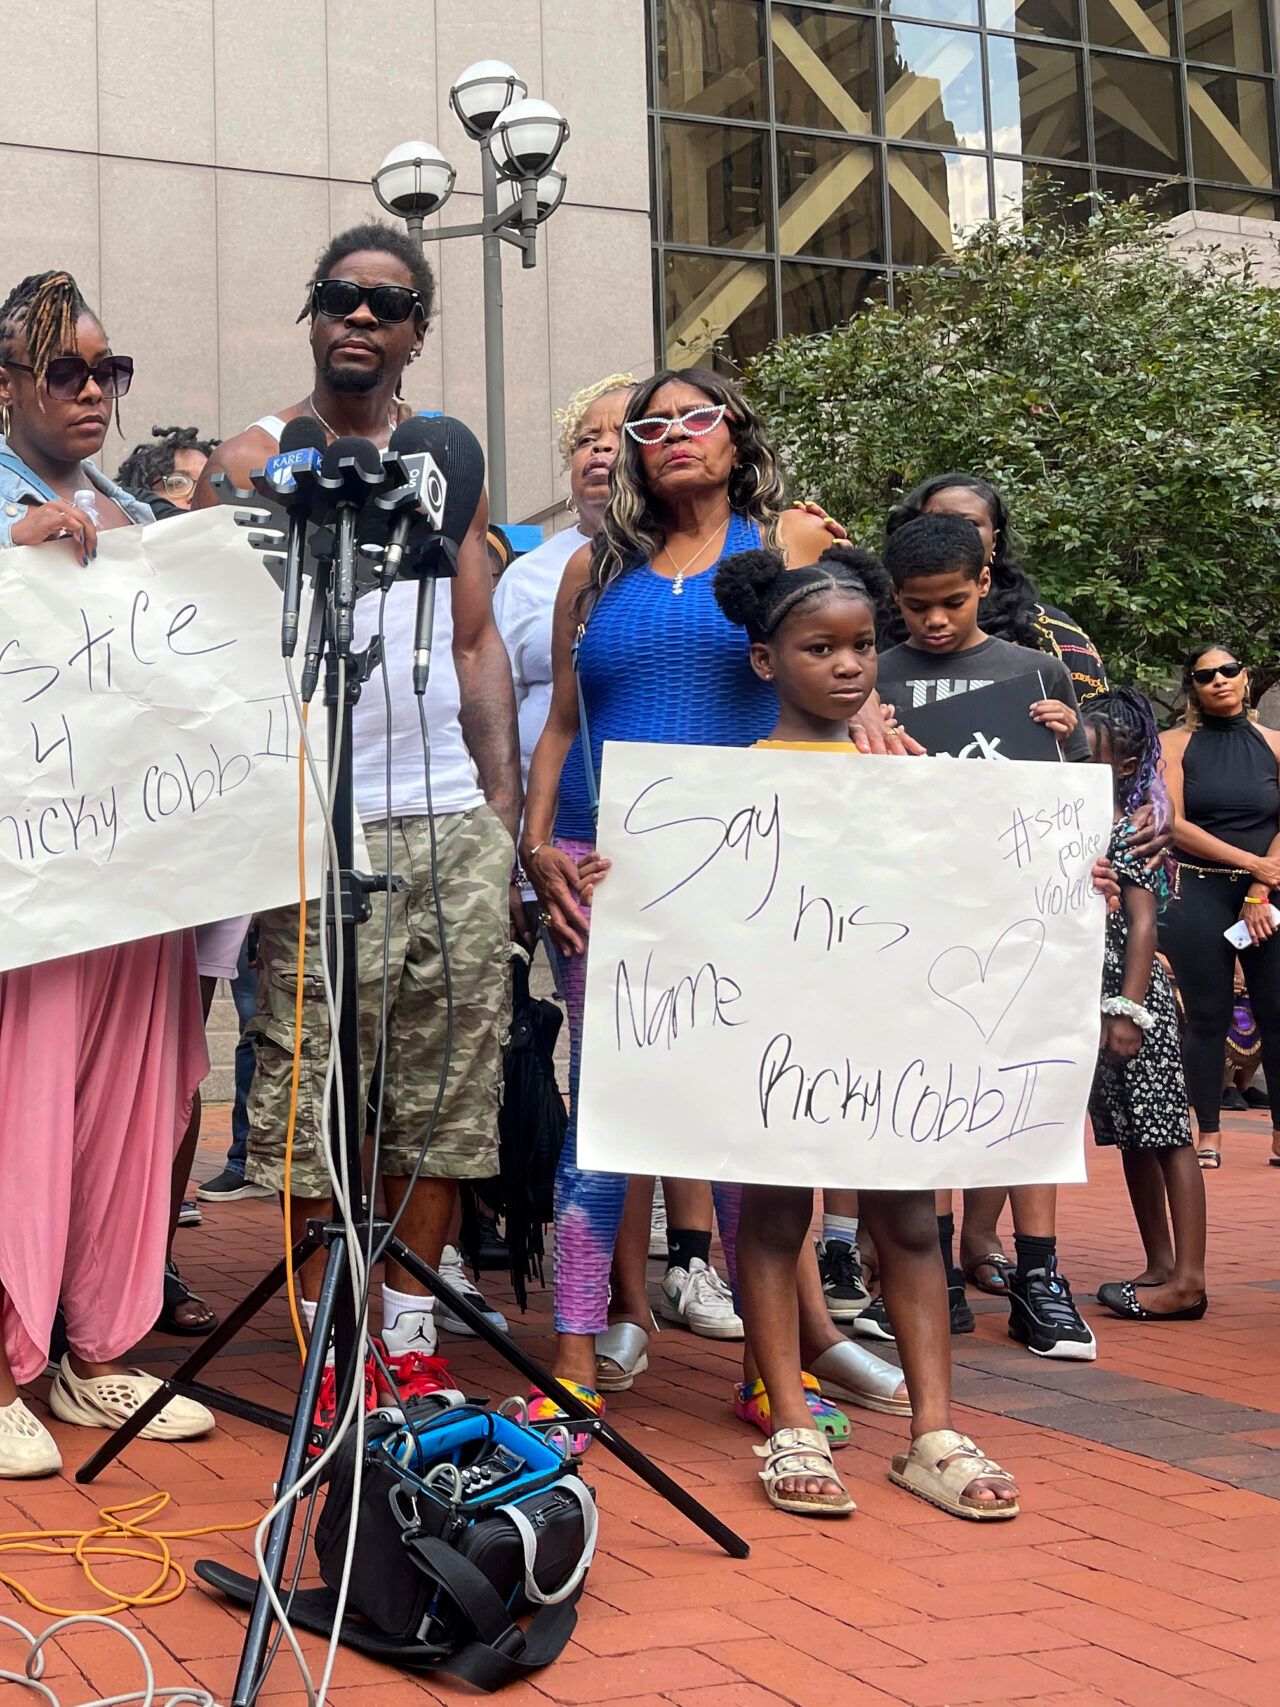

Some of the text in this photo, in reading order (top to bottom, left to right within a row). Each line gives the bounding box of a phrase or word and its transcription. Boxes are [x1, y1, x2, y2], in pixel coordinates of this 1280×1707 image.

[272, 452, 304, 469] KARE
[31, 714, 75, 788] 4
[144, 744, 250, 823] Cobb
[625, 776, 779, 921] Say
[793, 885, 909, 952] his
[615, 949, 749, 1051] Name
[759, 1033, 1077, 1148] Ricky Cobb II
